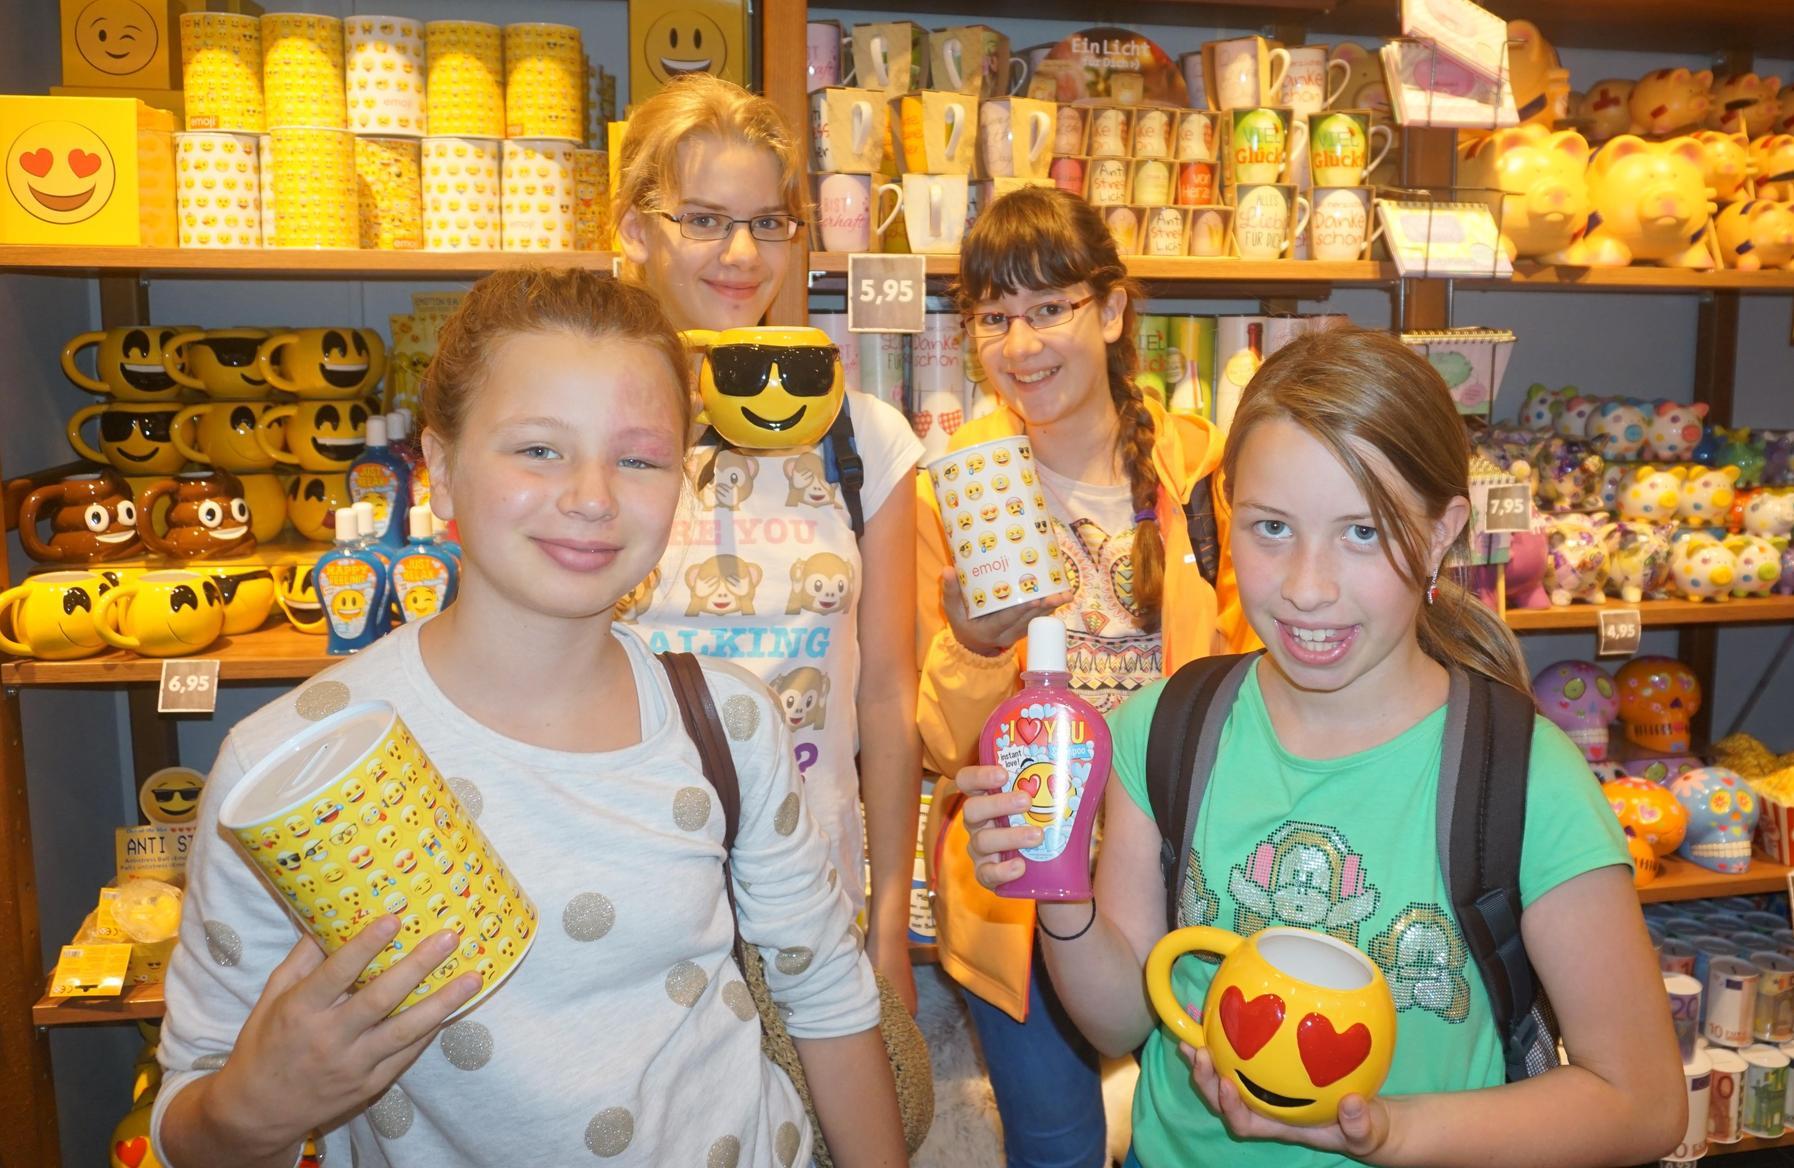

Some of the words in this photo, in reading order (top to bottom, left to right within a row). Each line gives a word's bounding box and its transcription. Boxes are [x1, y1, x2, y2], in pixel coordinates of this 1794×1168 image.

[1071, 38, 1100, 54] Ein
[1103, 39, 1150, 57] Licht
[190, 116, 217, 128] emoji
[859, 279, 914, 305] 5,95
[1490, 499, 1524, 516] 7,95
[667, 519, 722, 546] RE
[734, 517, 818, 545] YOU
[972, 554, 1009, 577] emoji
[1607, 623, 1636, 640] 4,95
[649, 625, 831, 659] ALKING
[168, 675, 210, 694] 6,95
[1009, 720, 1015, 743] I
[1043, 719, 1085, 744] YU
[1000, 749, 1022, 761] instant
[1005, 758, 1020, 769] love!
[127, 836, 166, 856] ANTI
